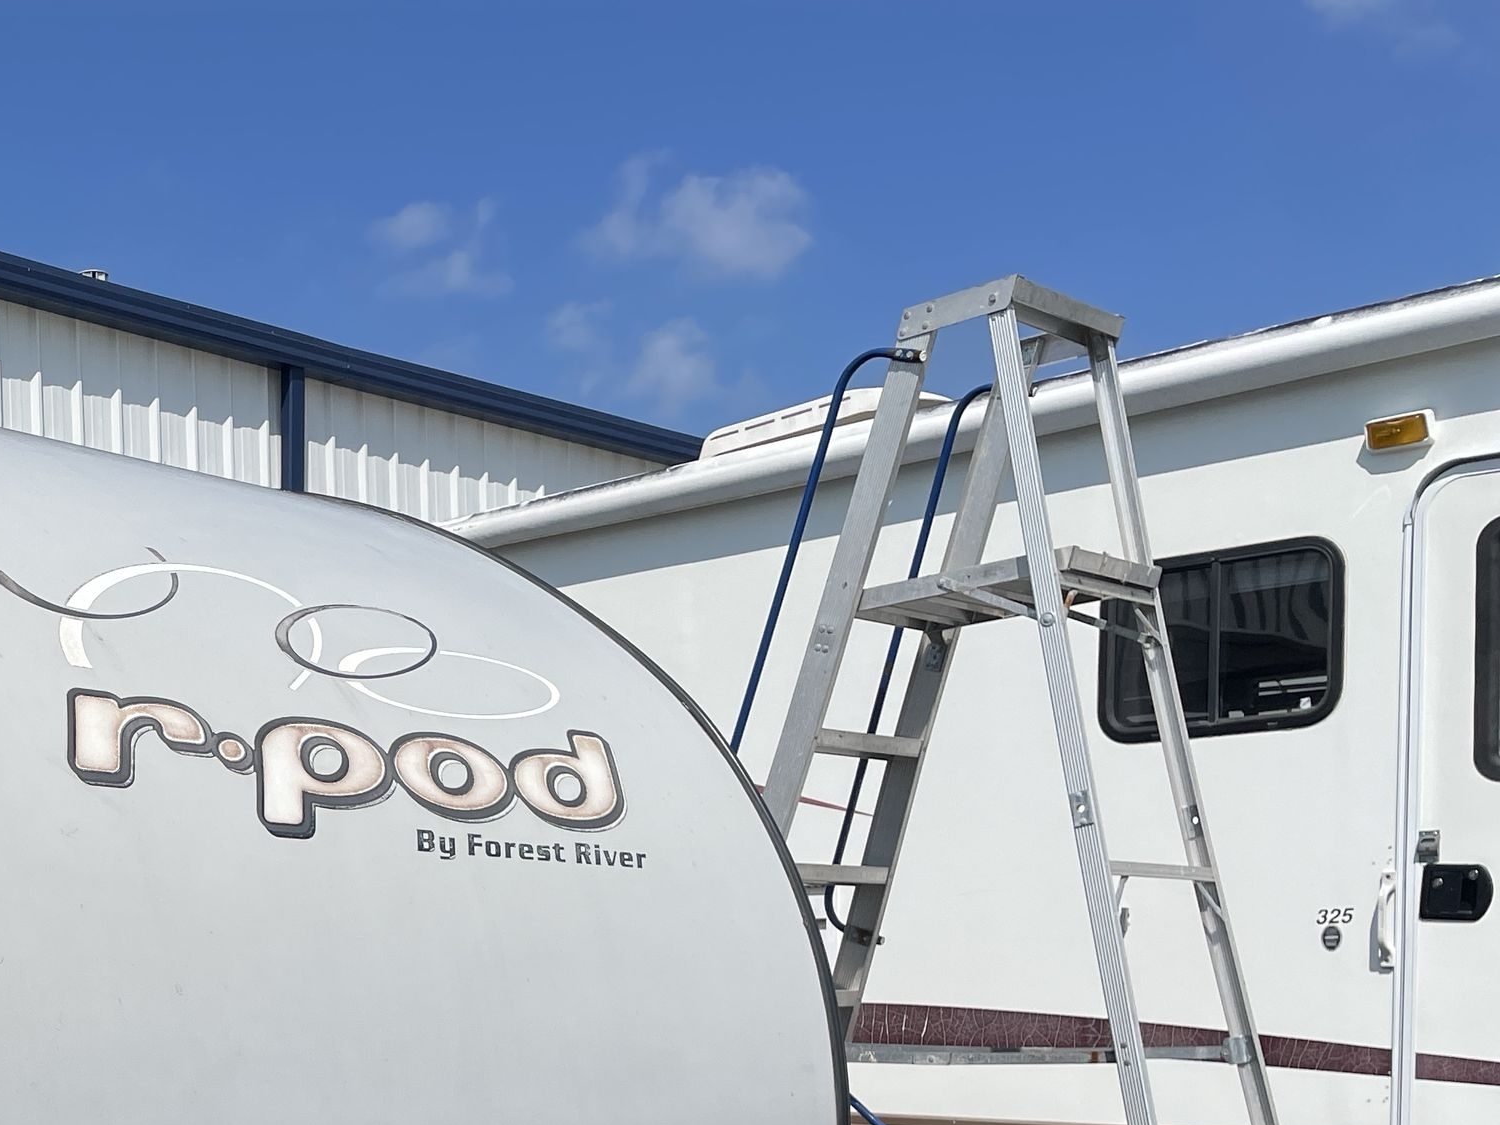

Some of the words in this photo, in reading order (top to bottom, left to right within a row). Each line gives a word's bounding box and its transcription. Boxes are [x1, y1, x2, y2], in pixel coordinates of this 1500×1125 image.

[416, 828, 456, 861] By
[467, 832, 566, 865] Forest
[575, 841, 648, 871] River
[1316, 907, 1355, 925] 325
